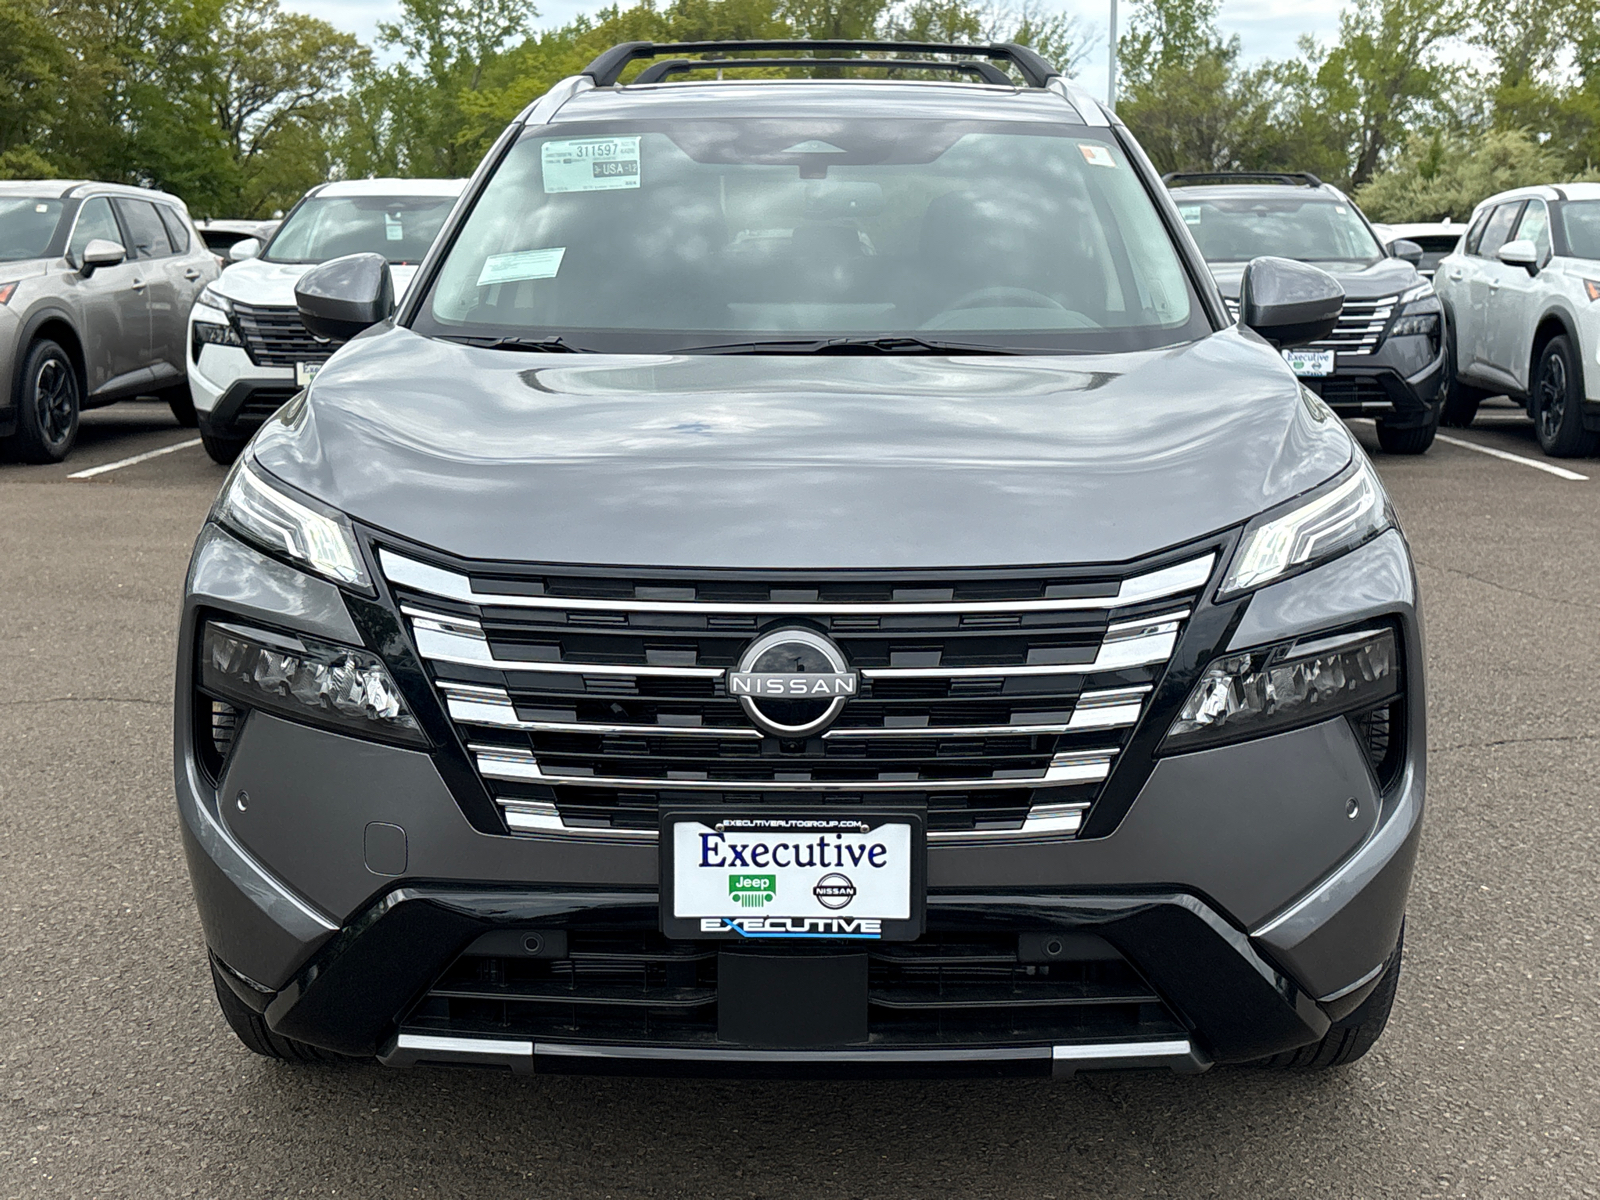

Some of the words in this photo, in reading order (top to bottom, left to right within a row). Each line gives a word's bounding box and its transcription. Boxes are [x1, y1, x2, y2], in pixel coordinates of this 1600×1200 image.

[576, 143, 618, 158] 311597
[1287, 352, 1329, 362] Executive
[732, 677, 854, 694] NISSAN
[722, 819, 862, 828] EXECUTIVEAUTOGROUP.COM
[698, 832, 888, 868] Executive
[735, 876, 770, 890] Jeep
[816, 887, 855, 895] NISSAN
[700, 918, 882, 937] EXECUTIVE
